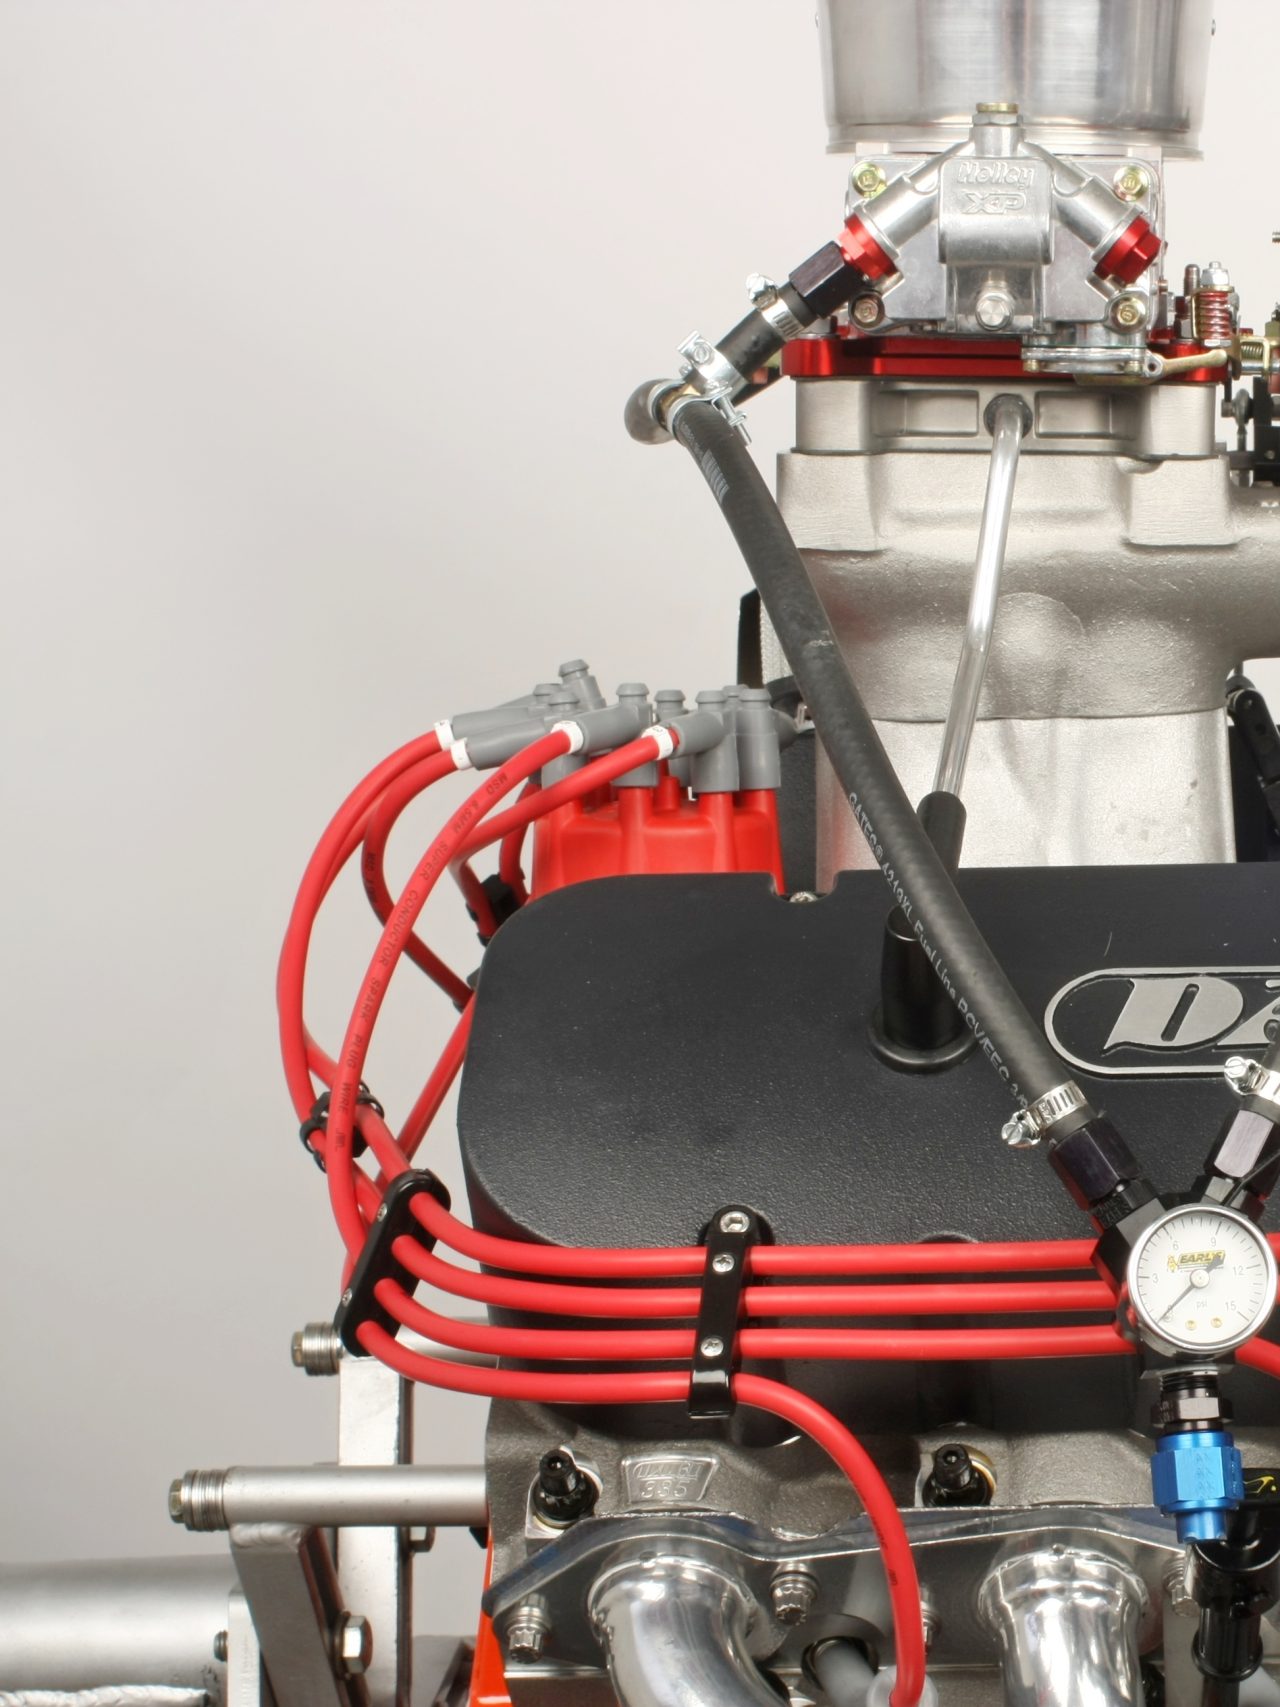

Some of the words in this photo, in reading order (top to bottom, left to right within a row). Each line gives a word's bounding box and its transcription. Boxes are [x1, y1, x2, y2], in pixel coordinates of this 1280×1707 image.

[957, 161, 1035, 190] Holley
[485, 773, 508, 795] MSD
[419, 840, 449, 880] SUPER
[378, 889, 418, 967] CONDUCTOR
[360, 977, 380, 1022] SPARK
[1172, 1239, 1179, 1250] 6
[1210, 1237, 1217, 1247] 9
[1233, 1265, 1244, 1275] 12
[1225, 1301, 1236, 1311] 15
